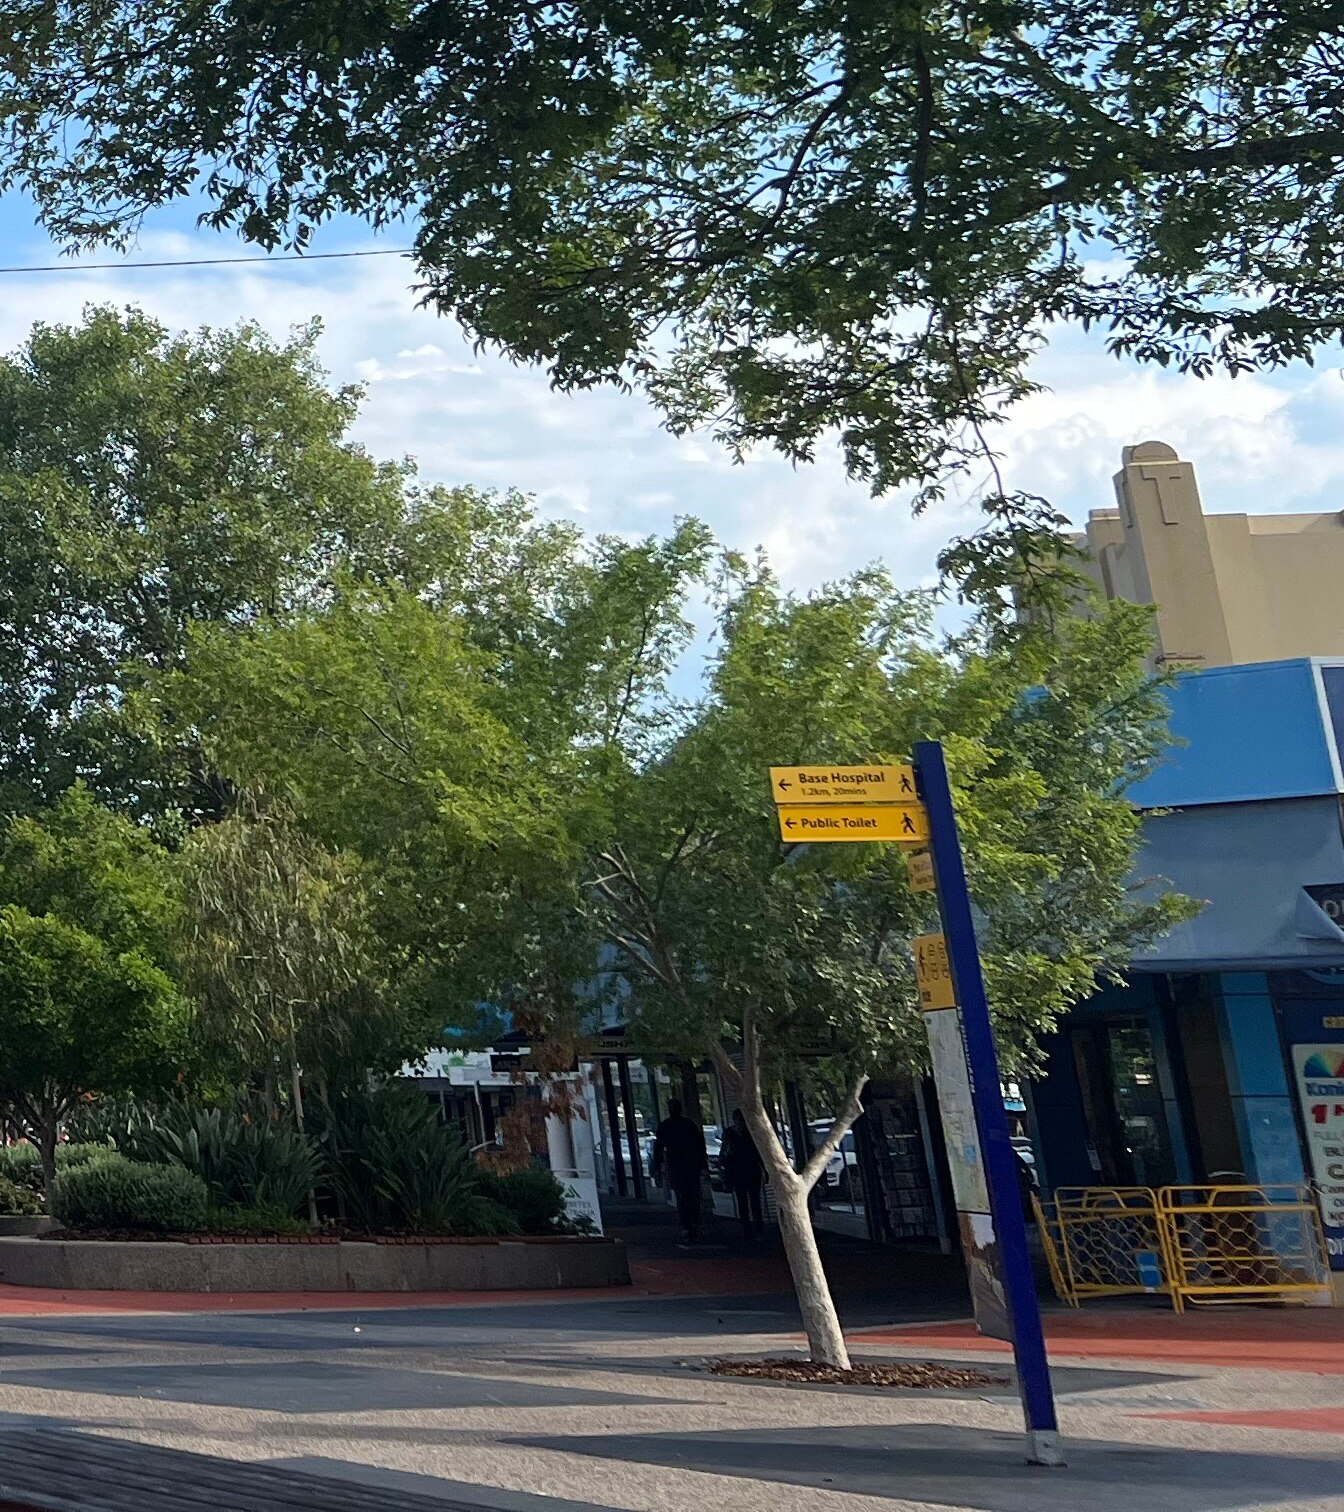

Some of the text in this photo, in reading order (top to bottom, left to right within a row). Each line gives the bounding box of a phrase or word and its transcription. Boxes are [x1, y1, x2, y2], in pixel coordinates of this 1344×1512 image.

[798, 770, 886, 785] Base Hospital
[800, 817, 878, 829] Public Toilet
